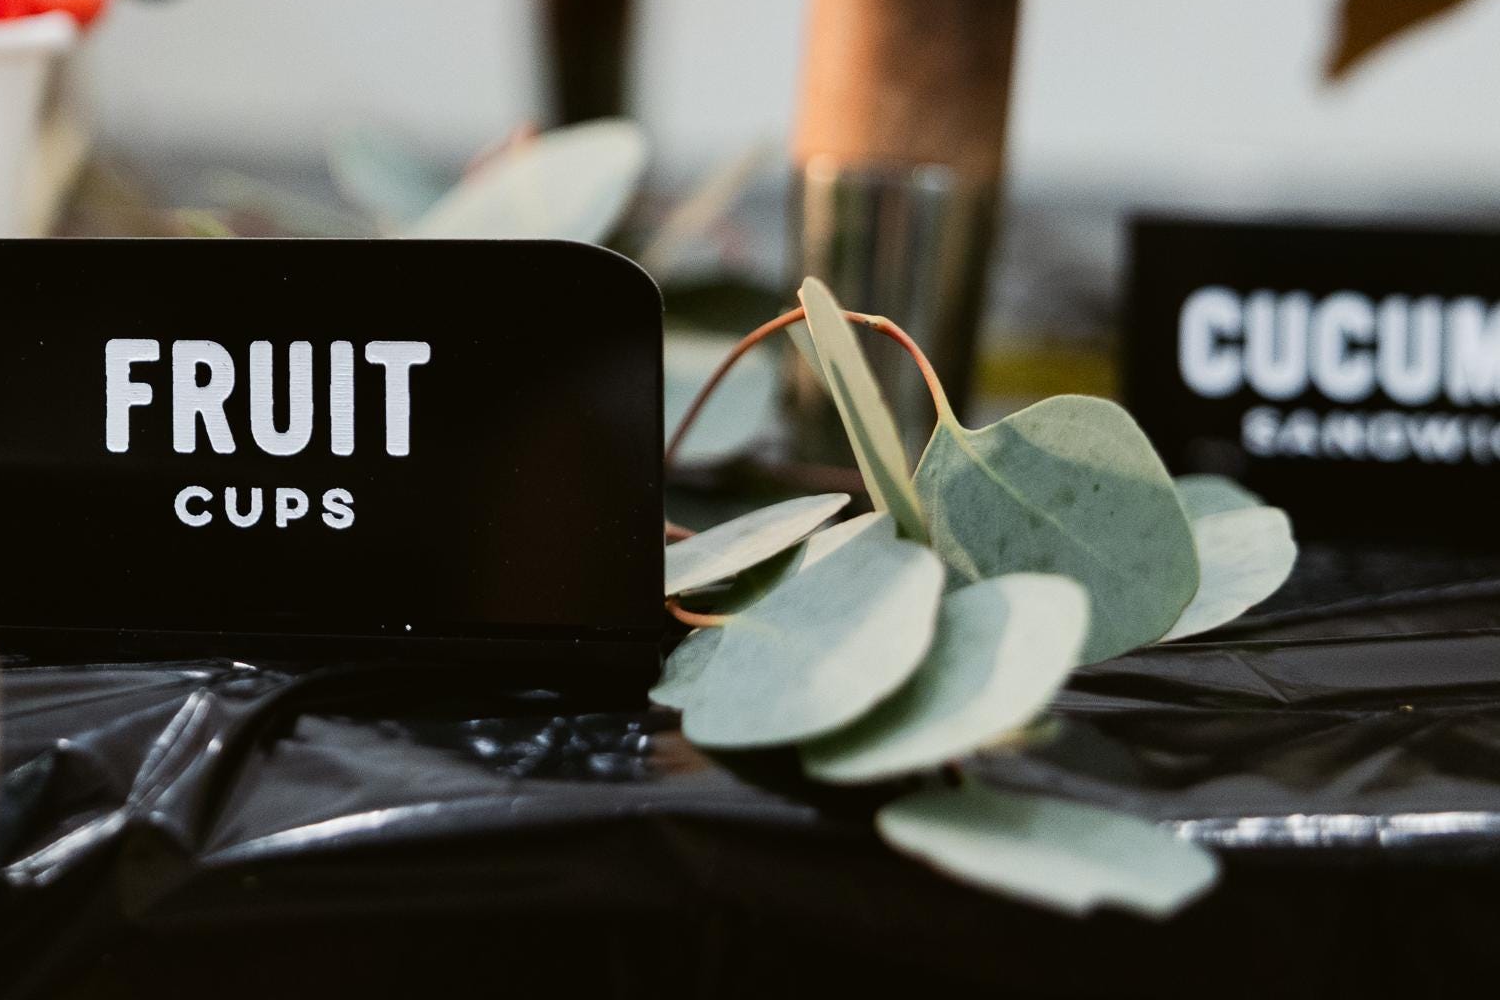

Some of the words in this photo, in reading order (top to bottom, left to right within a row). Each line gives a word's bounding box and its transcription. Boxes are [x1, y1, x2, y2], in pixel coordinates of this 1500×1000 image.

[105, 338, 431, 457] FRUIT
[1241, 407, 1500, 463] SANDWI
[174, 485, 356, 530] CUPS
